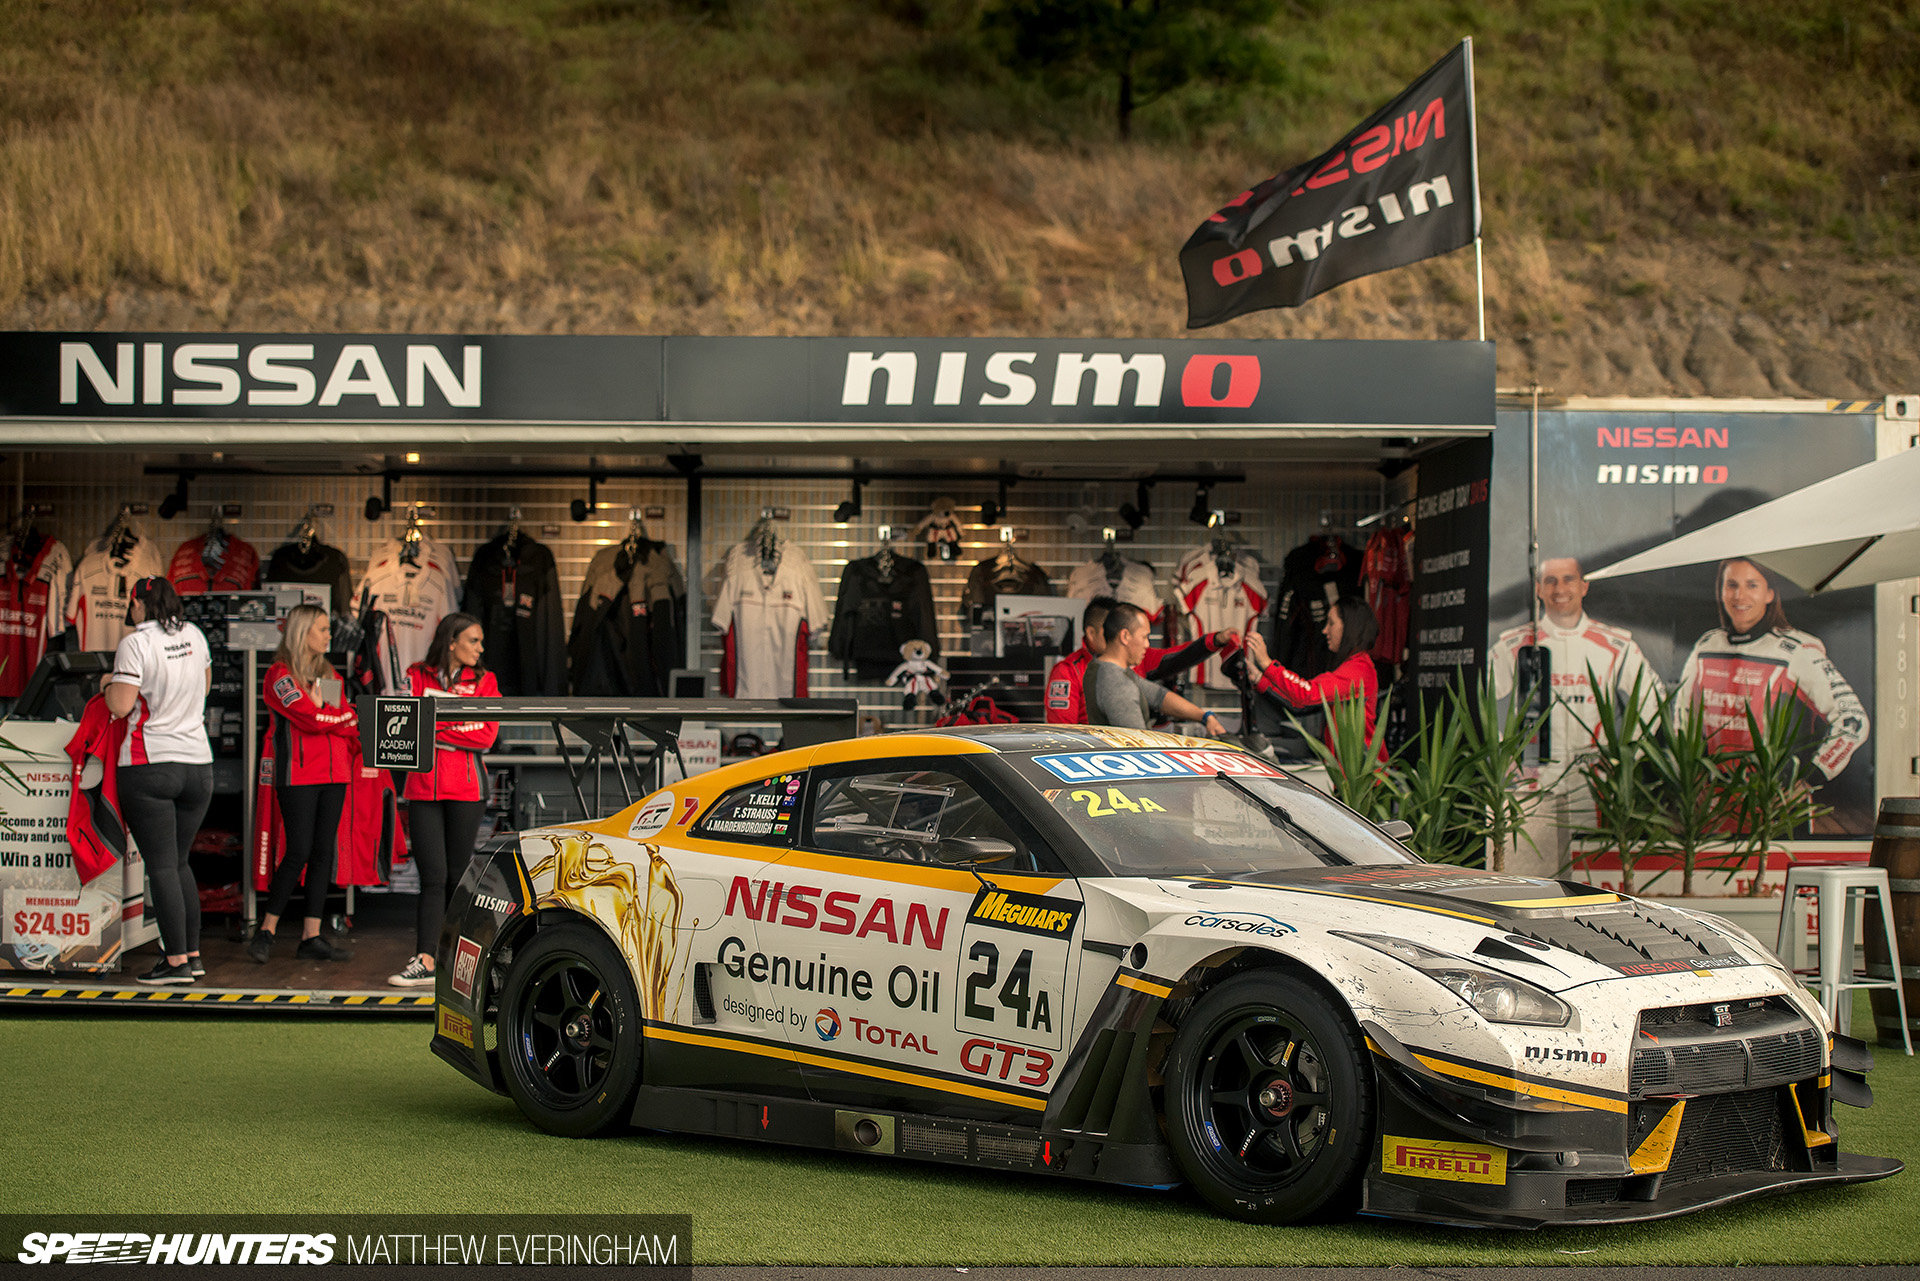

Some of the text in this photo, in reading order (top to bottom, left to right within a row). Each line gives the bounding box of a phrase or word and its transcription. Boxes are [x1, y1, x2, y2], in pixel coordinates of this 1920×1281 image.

[60, 341, 483, 408] NISSAN
[841, 351, 1262, 408] nismo
[1597, 427, 1729, 449] NISSAN
[1597, 463, 1729, 485] nismo
[384, 704, 412, 713] NISSAN
[379, 739, 415, 750] ACADEMY
[678, 740, 717, 750] SSAN
[387, 752, 414, 762] PlayStation
[1045, 752, 1275, 779] LIQUI MOLY
[26, 788, 70, 797] nism
[749, 793, 783, 806] T.KELLY
[1070, 788, 1167, 818] 24A
[0, 817, 36, 828] ecome
[38, 818, 45, 828] a
[733, 807, 778, 820] F.STRAUSS
[706, 820, 774, 834] J.MARDENBOROUGH
[1, 832, 29, 843] today
[31, 832, 50, 842] and
[1, 852, 73, 868] Win a HOT
[26, 897, 80, 907] MEMBERSHIP
[475, 893, 517, 915] nismo
[14, 910, 90, 937] $24.95
[724, 876, 950, 951] NISSAN
[1184, 913, 1291, 938] carsales
[458, 950, 476, 967] AUTO
[1620, 961, 1693, 976] NISSAN
[718, 936, 940, 1014] Genuine Oil
[965, 940, 1052, 1034] 24A
[723, 994, 808, 1032] designed by
[960, 1038, 1055, 1087] GT3
[1525, 1046, 1607, 1064] nismo
[1396, 1144, 1492, 1175] PIRELLI
